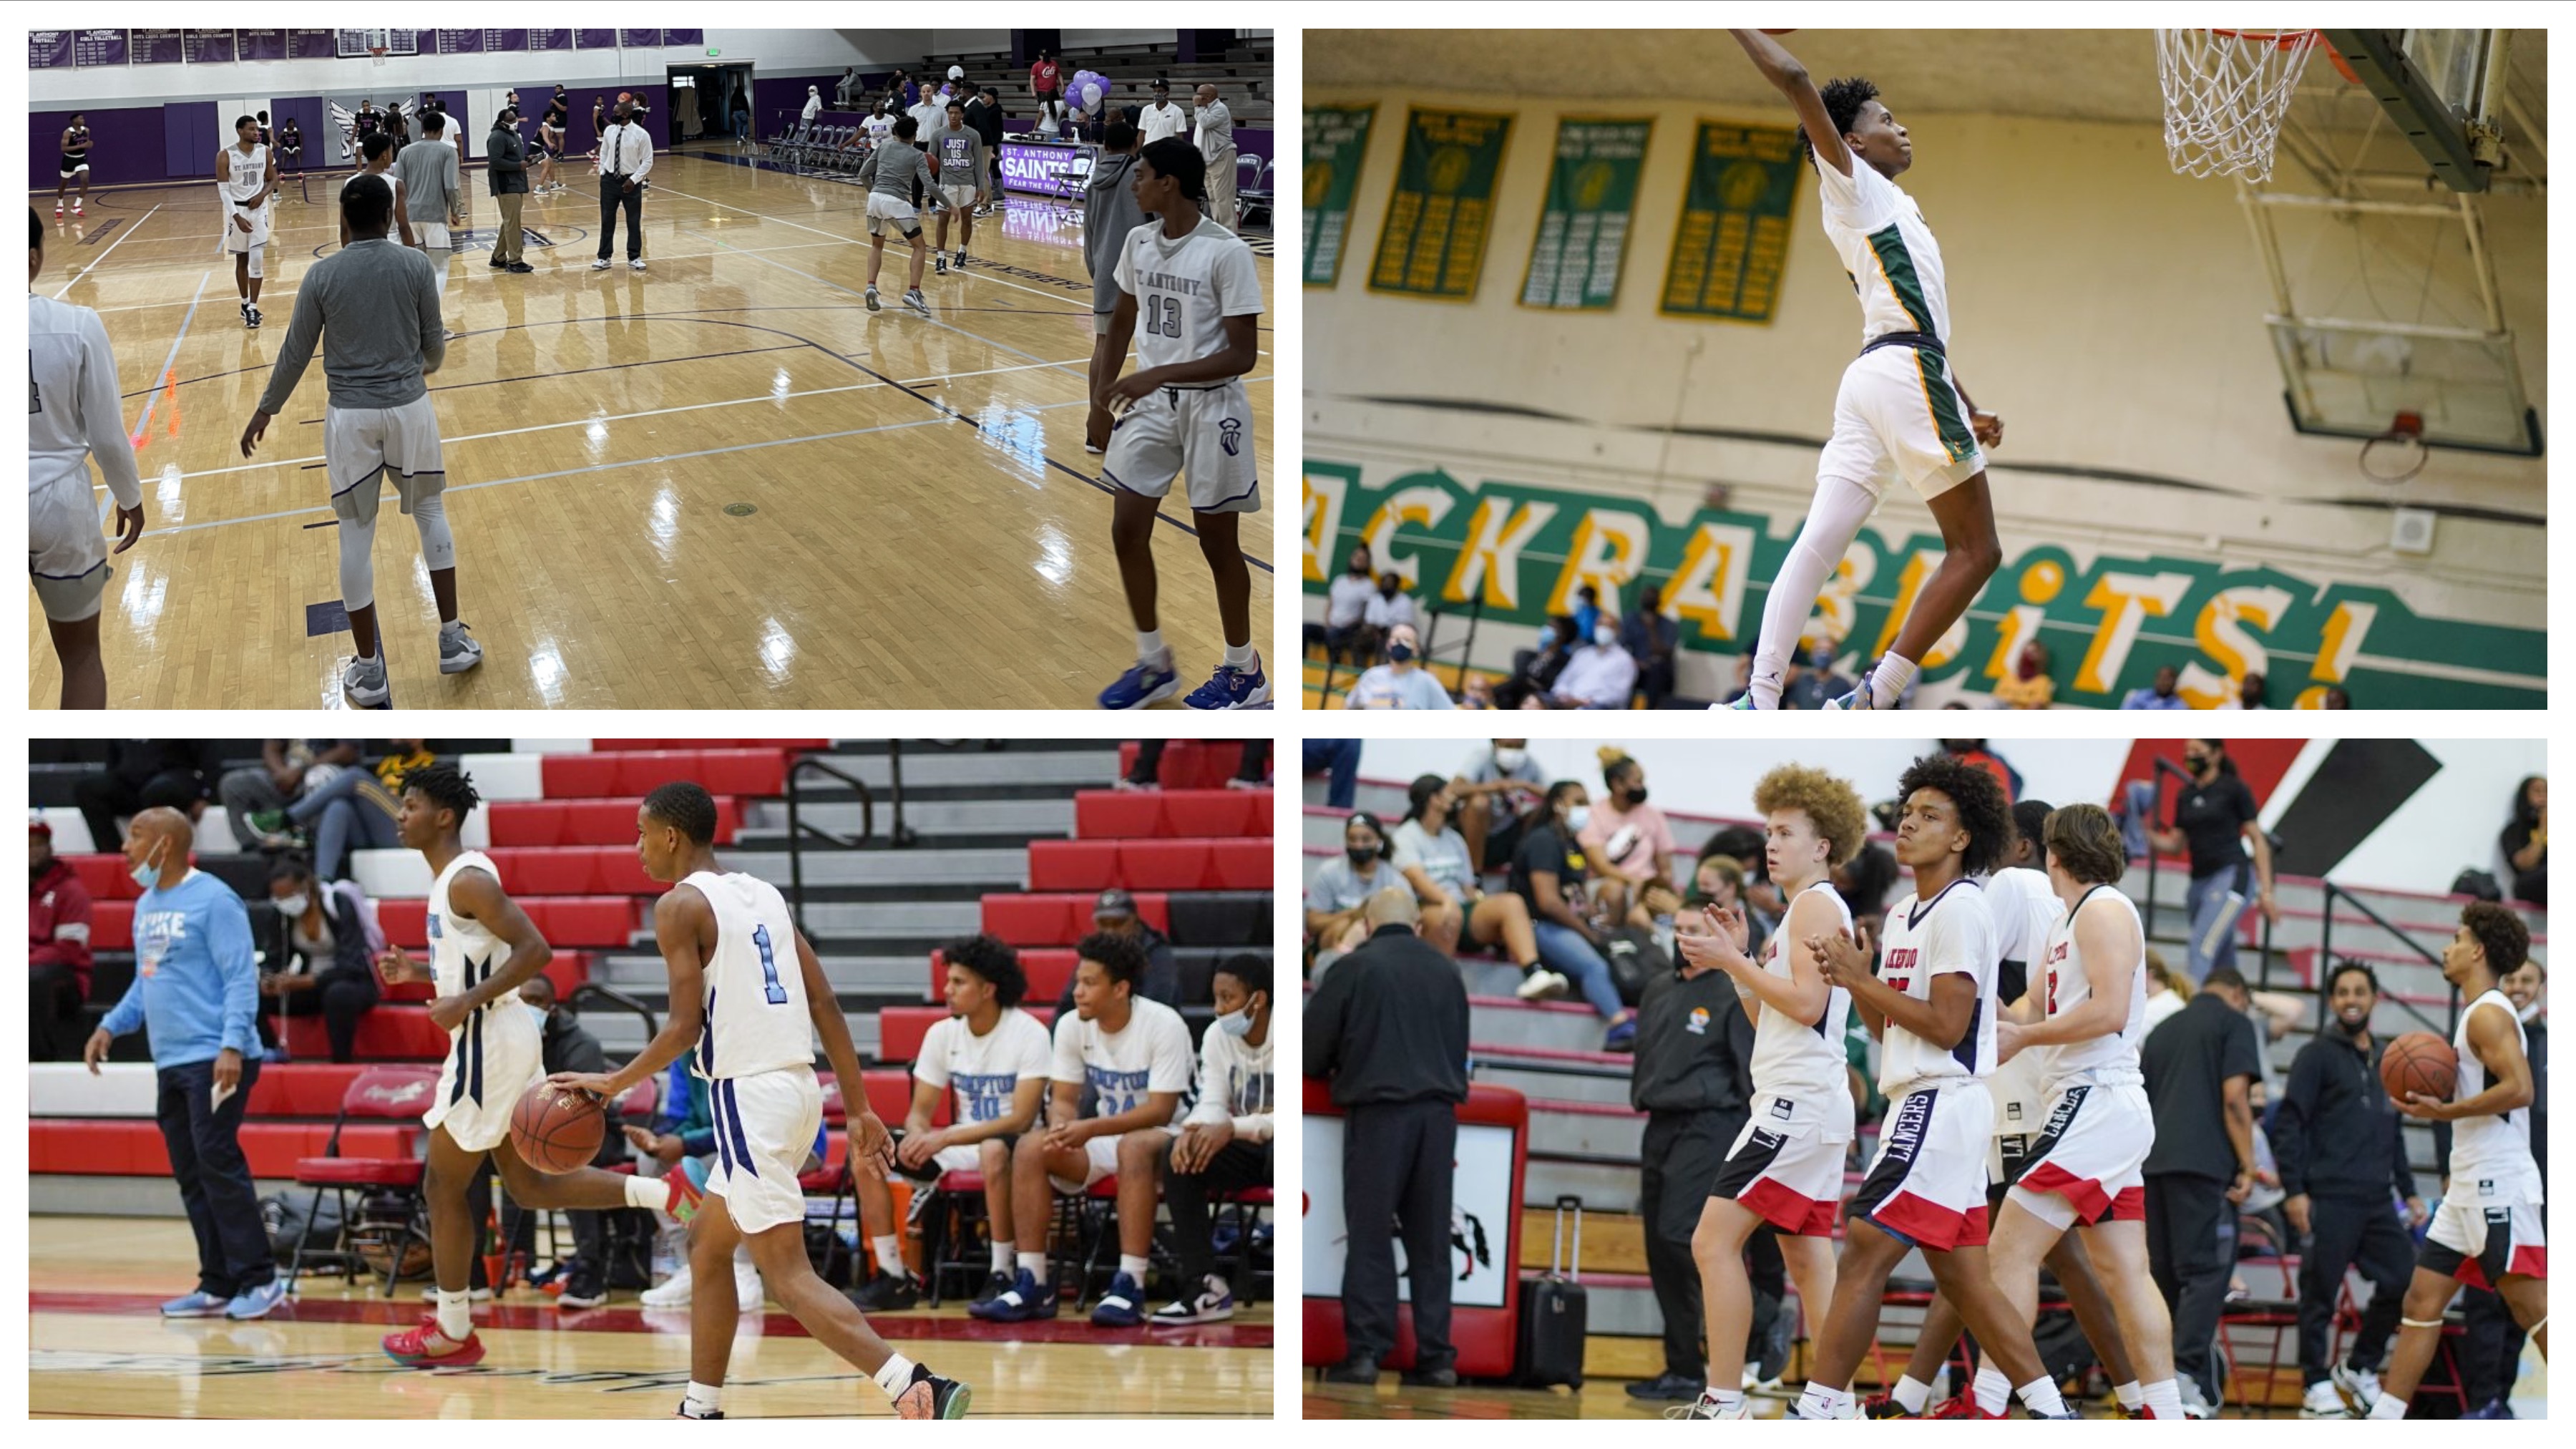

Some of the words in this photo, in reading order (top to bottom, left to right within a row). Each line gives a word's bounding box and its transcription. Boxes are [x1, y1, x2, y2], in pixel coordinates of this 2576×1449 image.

[946, 139, 965, 149] JUST
[951, 149, 962, 158] US
[1007, 147, 1020, 157] ST.
[1023, 149, 1070, 161] ANTHONY
[944, 158, 970, 167] SAINTS
[243, 171, 257, 186] 10
[1147, 294, 1181, 338] 13
[753, 924, 788, 1005] 1
[1888, 1095, 1929, 1163] LANCERS
